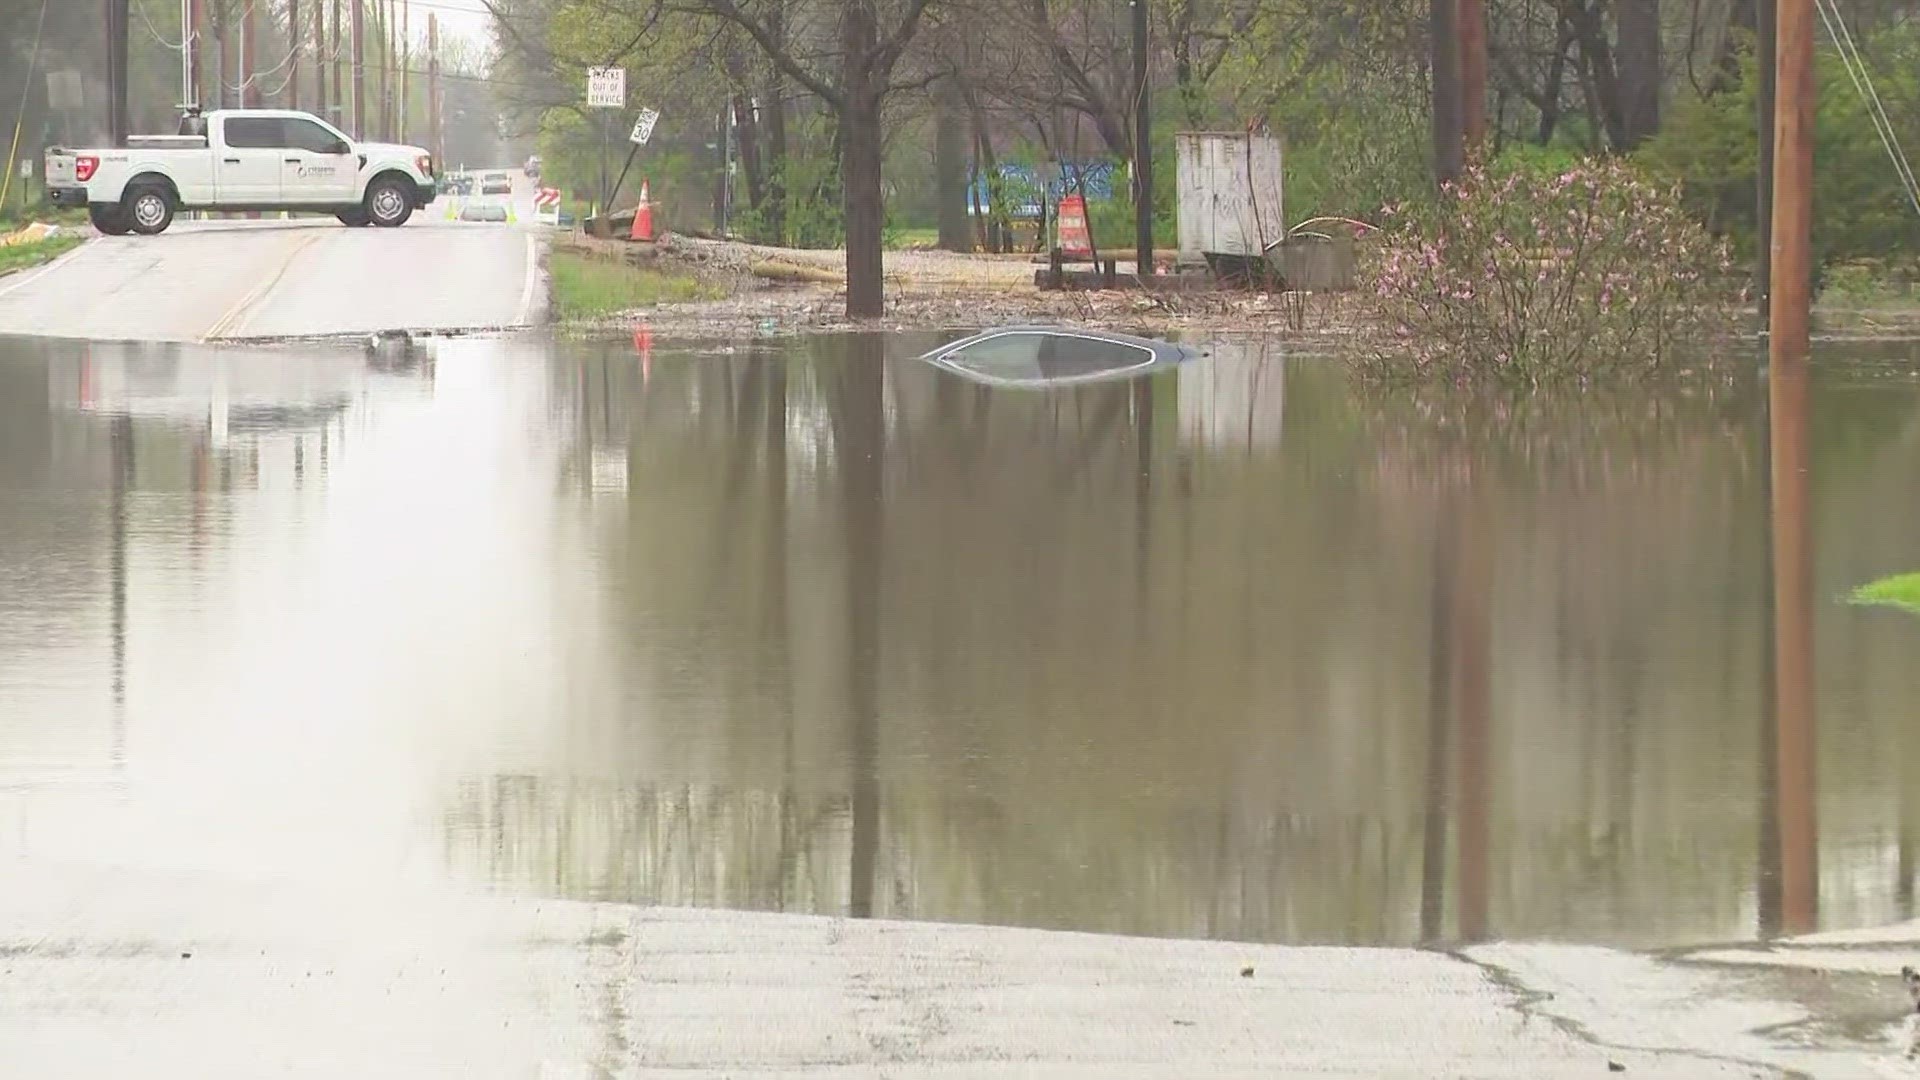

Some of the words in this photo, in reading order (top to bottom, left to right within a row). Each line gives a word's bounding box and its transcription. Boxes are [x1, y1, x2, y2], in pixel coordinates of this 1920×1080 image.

[593, 83, 605, 91] OUT
[610, 83, 618, 91] OF
[634, 125, 649, 140] 30
